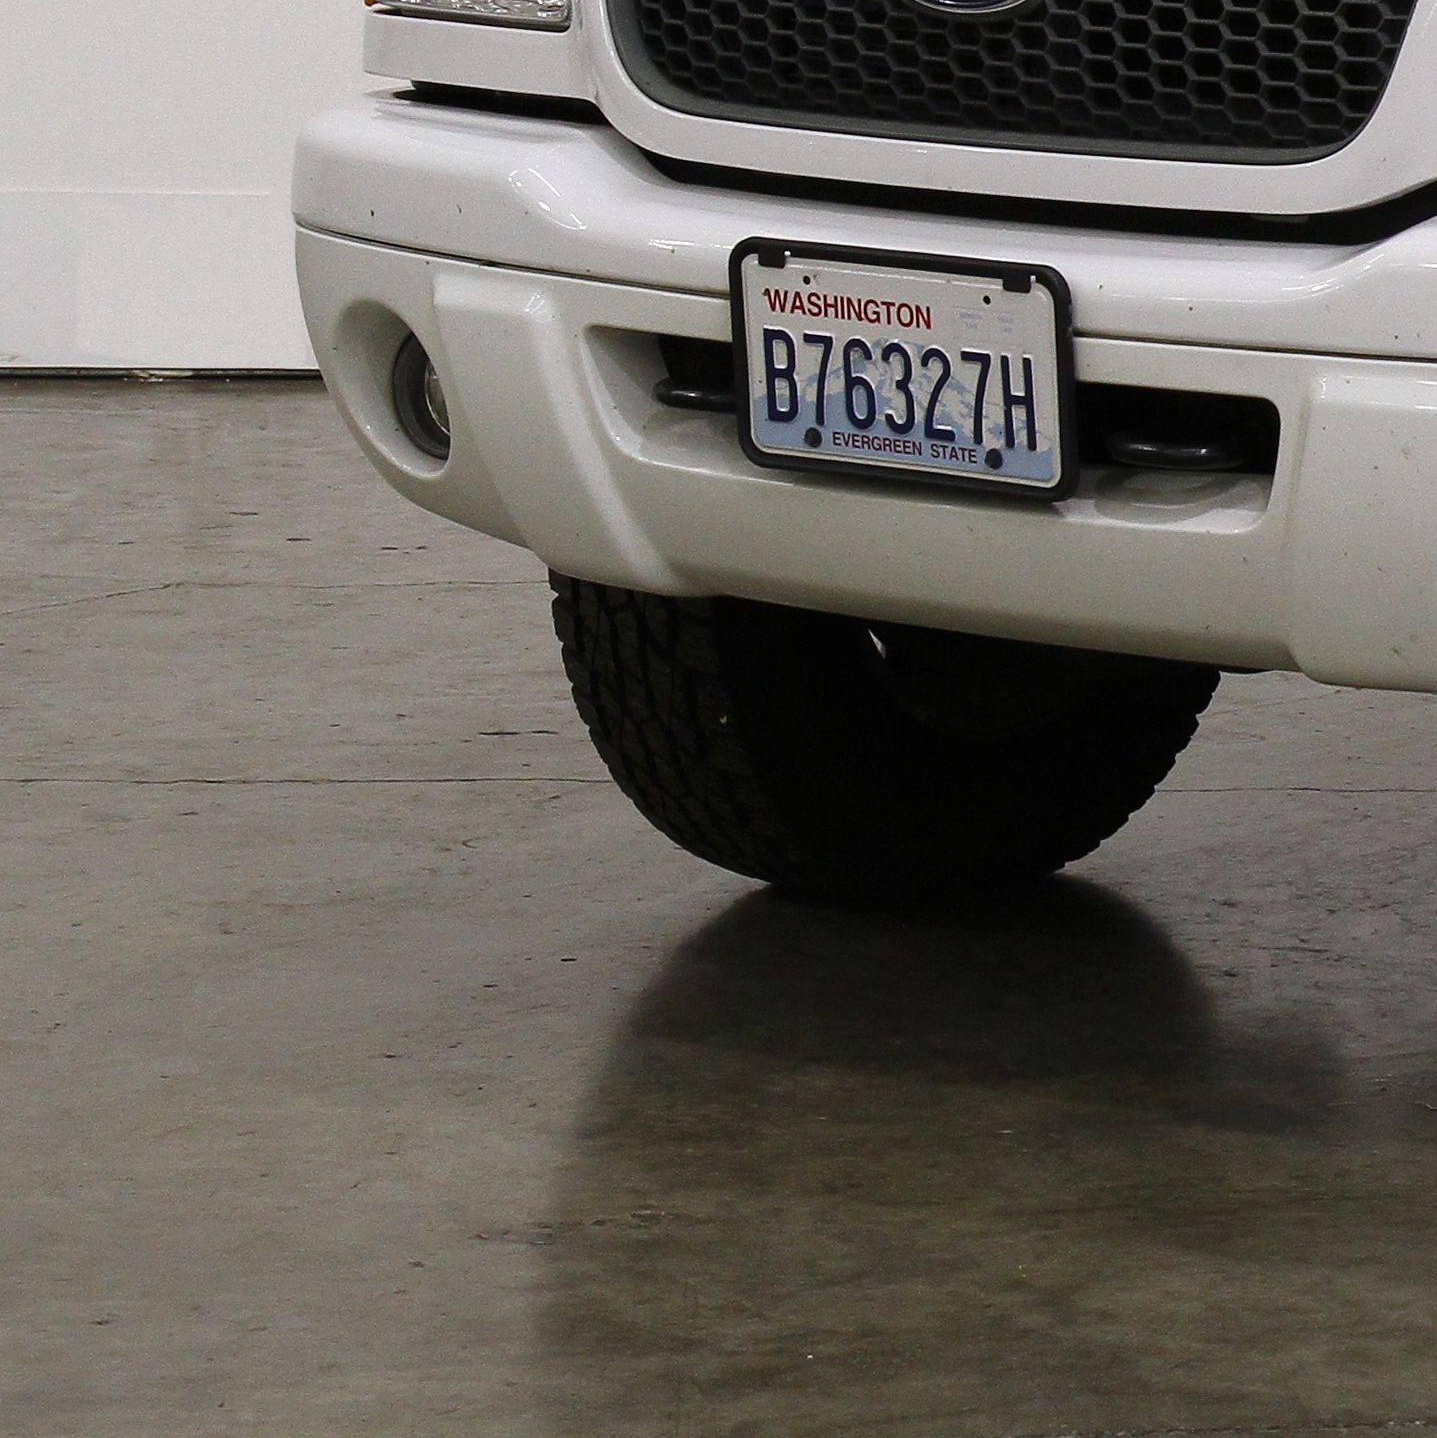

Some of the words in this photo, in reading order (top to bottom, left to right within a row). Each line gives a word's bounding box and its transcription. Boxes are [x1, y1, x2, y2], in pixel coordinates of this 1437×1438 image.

[763, 287, 932, 330] WASHINGTON
[763, 327, 1038, 452] B76327H
[832, 430, 923, 457] EVERGREEN
[930, 443, 978, 464] STATE
